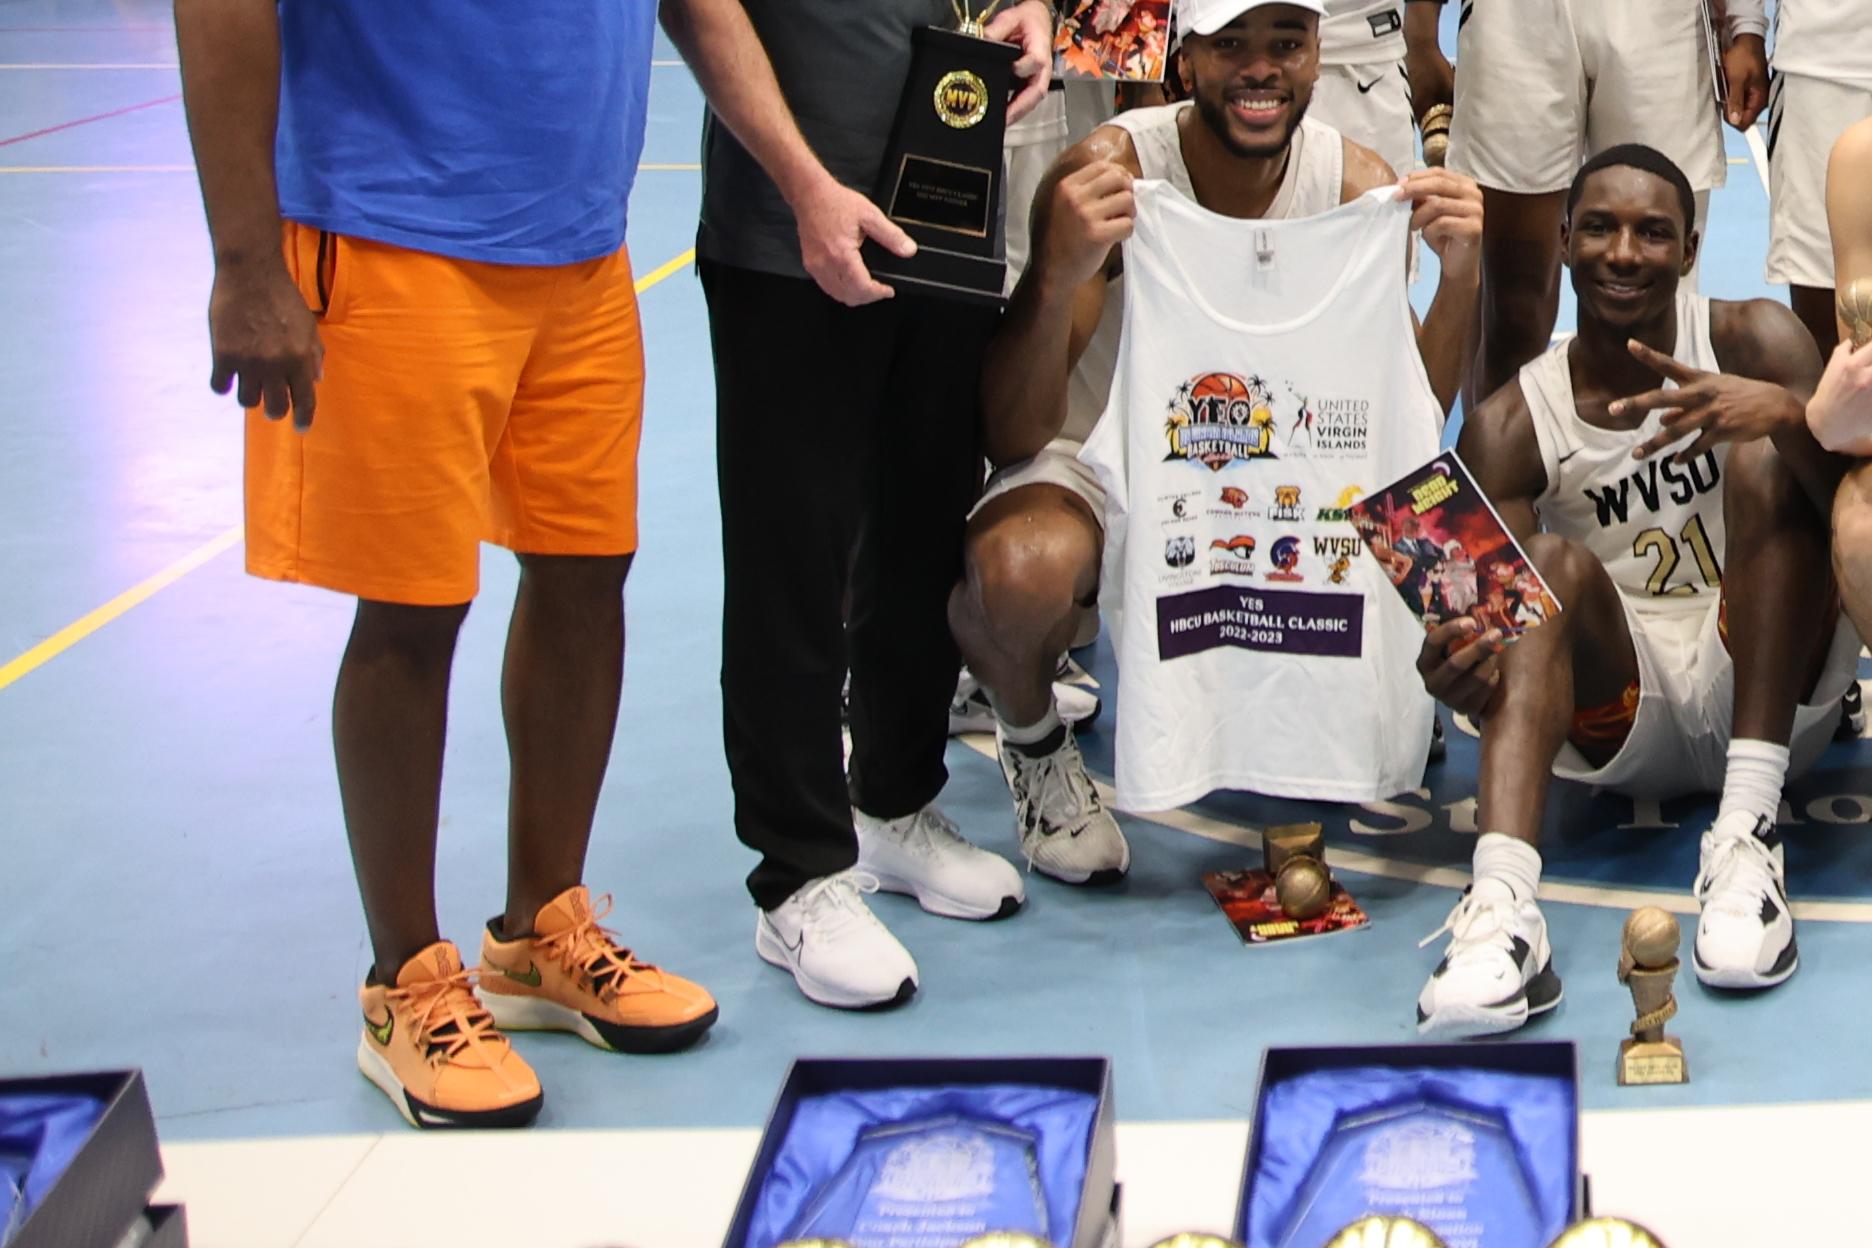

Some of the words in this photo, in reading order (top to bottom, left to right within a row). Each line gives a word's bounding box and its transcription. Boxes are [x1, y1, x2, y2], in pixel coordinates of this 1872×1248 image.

[945, 88, 979, 111] MVP
[1318, 399, 1369, 412] UNITED
[1317, 413, 1368, 426] STATES
[1317, 427, 1367, 438] VIRGIN
[1317, 440, 1367, 450] ISLANDS
[1582, 449, 1720, 528] WVSU
[1313, 536, 1362, 557] WVSU
[1633, 512, 1722, 595] 21
[1239, 595, 1264, 612] YES
[1170, 613, 1202, 635] HBCU
[1203, 609, 1285, 629] BASKETBALL
[1288, 616, 1348, 632] CLASSIC
[1219, 625, 1283, 644] 2022-2023
